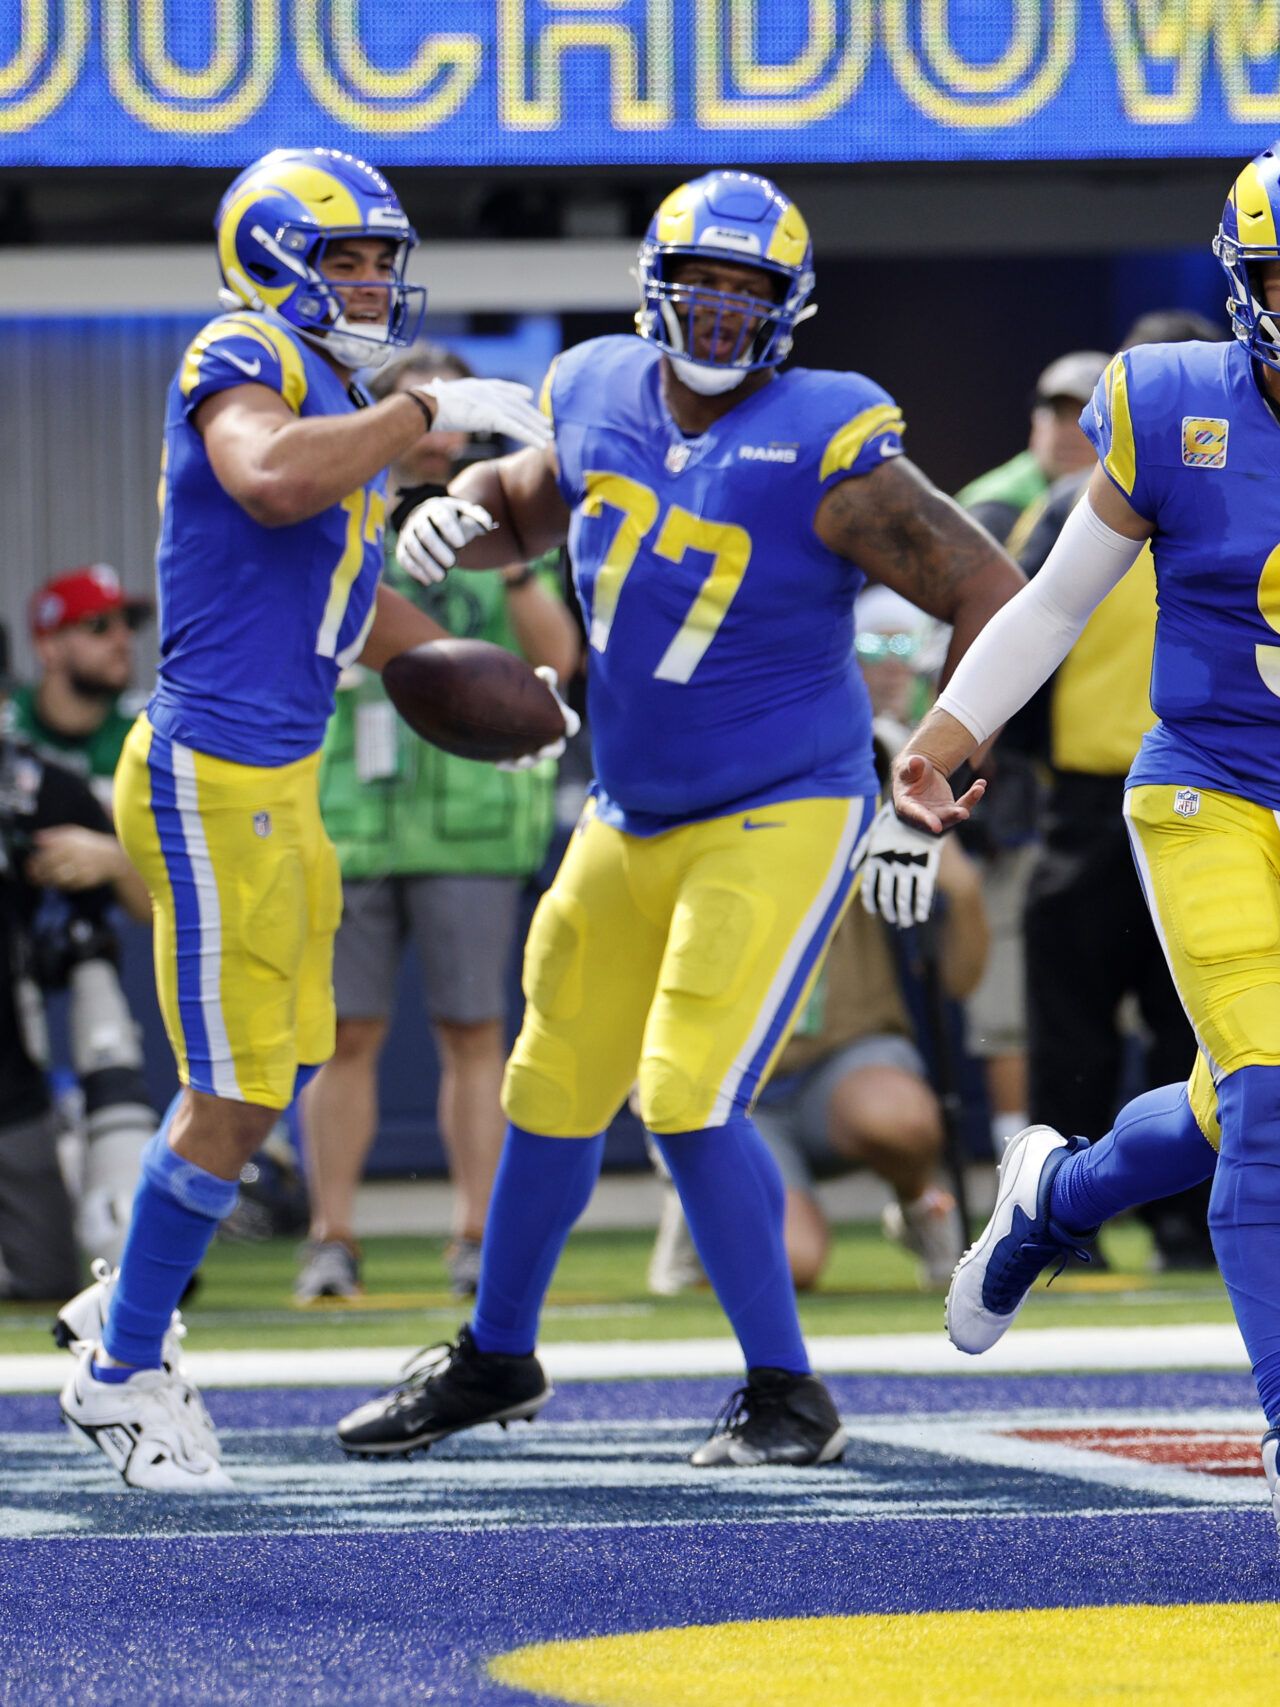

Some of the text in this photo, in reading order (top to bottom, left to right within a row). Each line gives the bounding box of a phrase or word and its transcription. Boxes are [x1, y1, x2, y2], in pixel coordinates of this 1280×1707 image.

[1186, 420, 1225, 454] C
[739, 446, 797, 463] RAMS
[575, 470, 752, 685] 77
[1178, 800, 1195, 812] NFL
